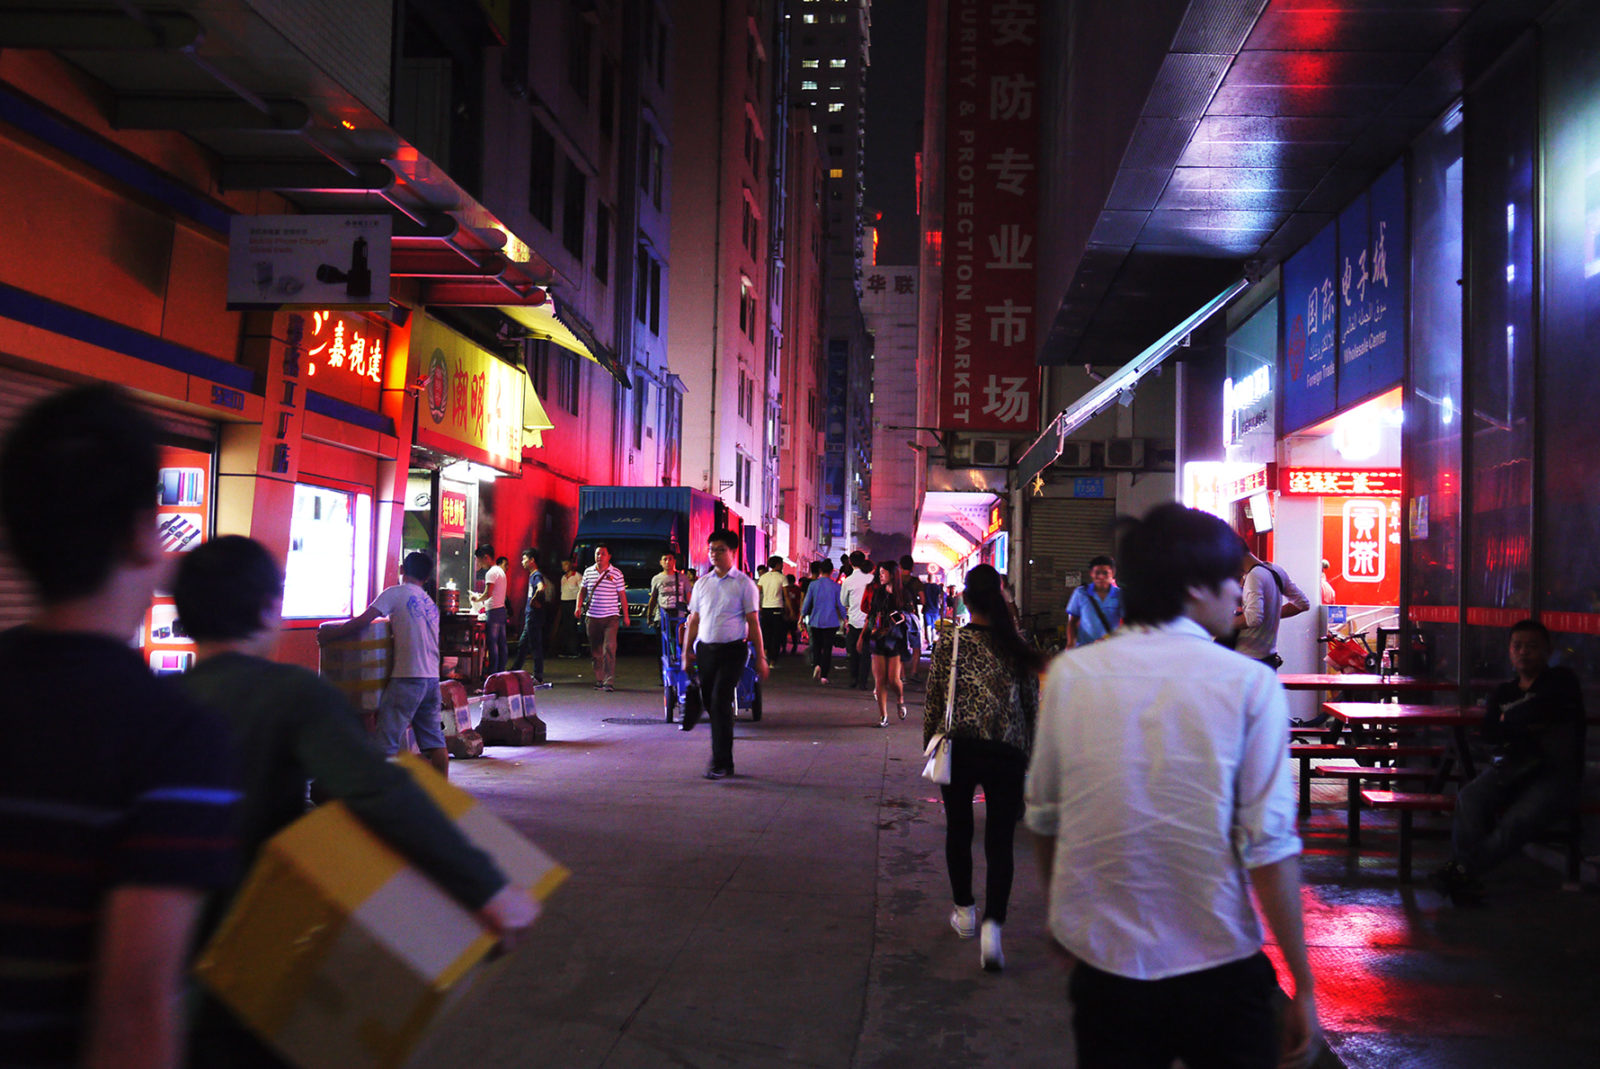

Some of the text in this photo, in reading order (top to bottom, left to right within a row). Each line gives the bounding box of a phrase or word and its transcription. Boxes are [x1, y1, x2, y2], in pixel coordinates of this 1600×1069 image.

[953, 0, 977, 424] URITY & PROTECTION MARKET
[981, 0, 1037, 423] 安防专业市场
[866, 274, 915, 295] 华联
[1307, 221, 1389, 337] 国际电子城
[1343, 335, 1369, 364] Wholesale
[1368, 330, 1388, 351] Center
